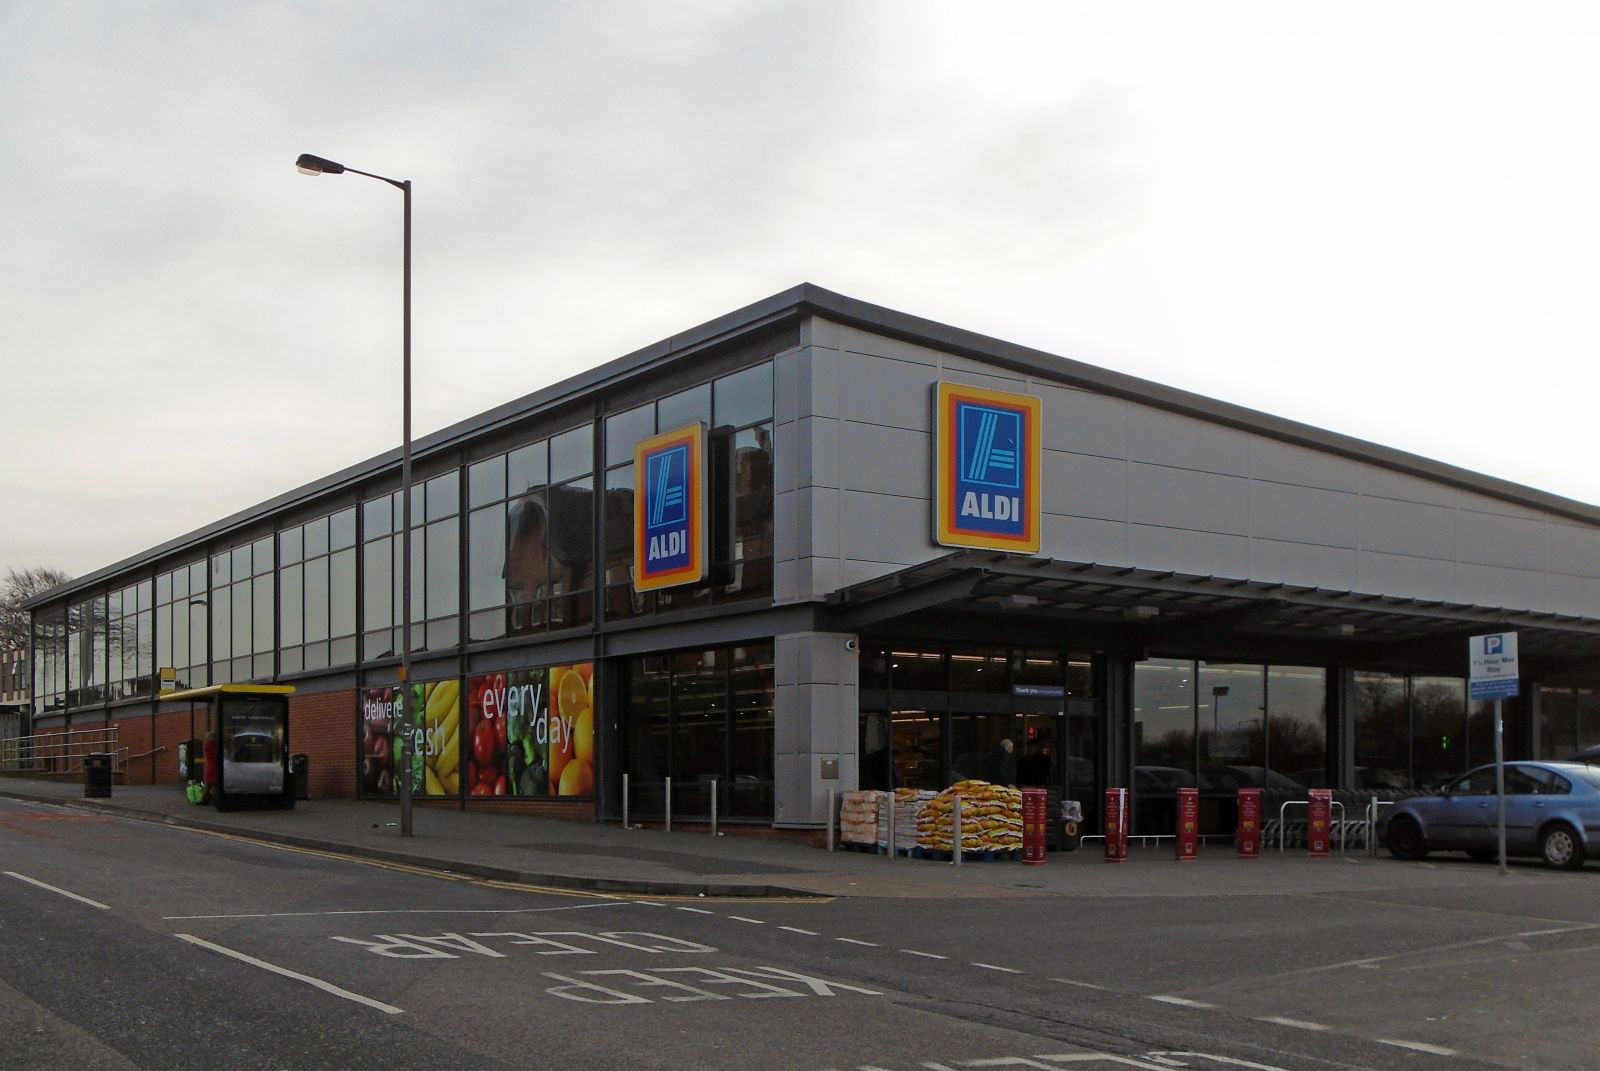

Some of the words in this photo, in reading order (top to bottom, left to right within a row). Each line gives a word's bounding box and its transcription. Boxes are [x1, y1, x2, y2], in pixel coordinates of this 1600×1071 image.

[961, 491, 1019, 522] ALDI
[649, 529, 686, 561] ALDI
[483, 683, 541, 727] every
[409, 718, 446, 756] resh
[536, 707, 573, 753] day
[329, 930, 719, 959] CLEAR
[540, 965, 883, 1005] KEEP
